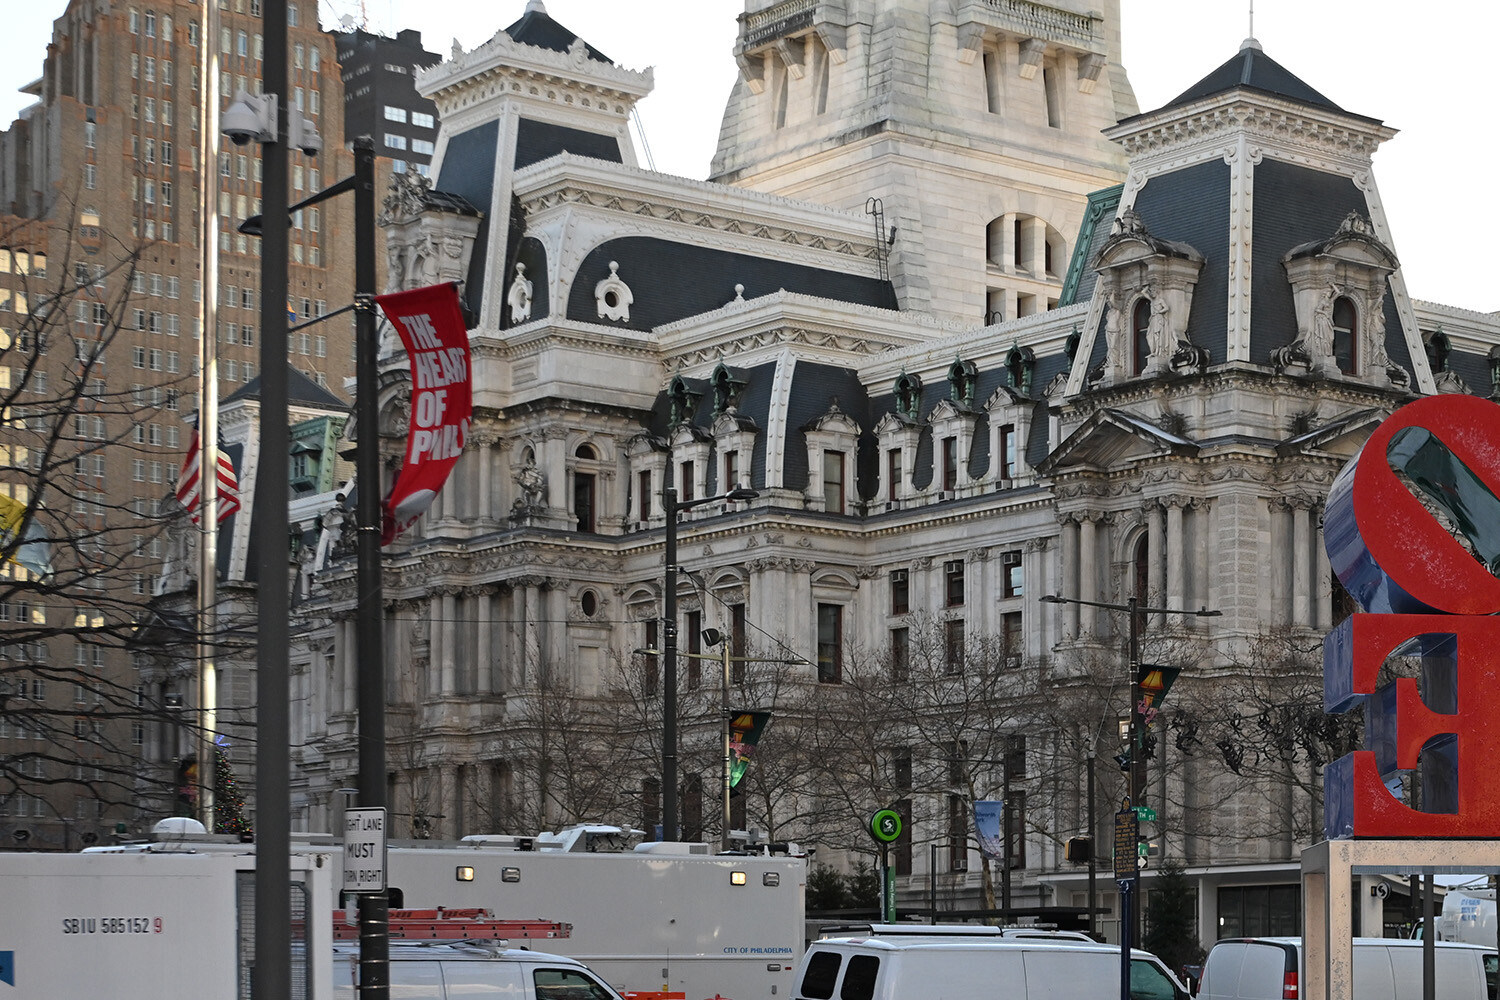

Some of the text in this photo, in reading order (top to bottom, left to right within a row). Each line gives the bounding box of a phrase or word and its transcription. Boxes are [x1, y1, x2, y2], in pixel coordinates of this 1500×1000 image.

[399, 313, 443, 350] THE
[414, 347, 468, 390] HEART
[416, 389, 448, 428] OF
[410, 415, 472, 465] PHILL
[363, 818, 382, 831] LANE
[347, 842, 376, 858] MUST
[359, 869, 382, 882] RIGHT
[62, 917, 163, 935] SBIU 585152 9
[723, 946, 793, 954] CITY OF PHILADELPHIA
